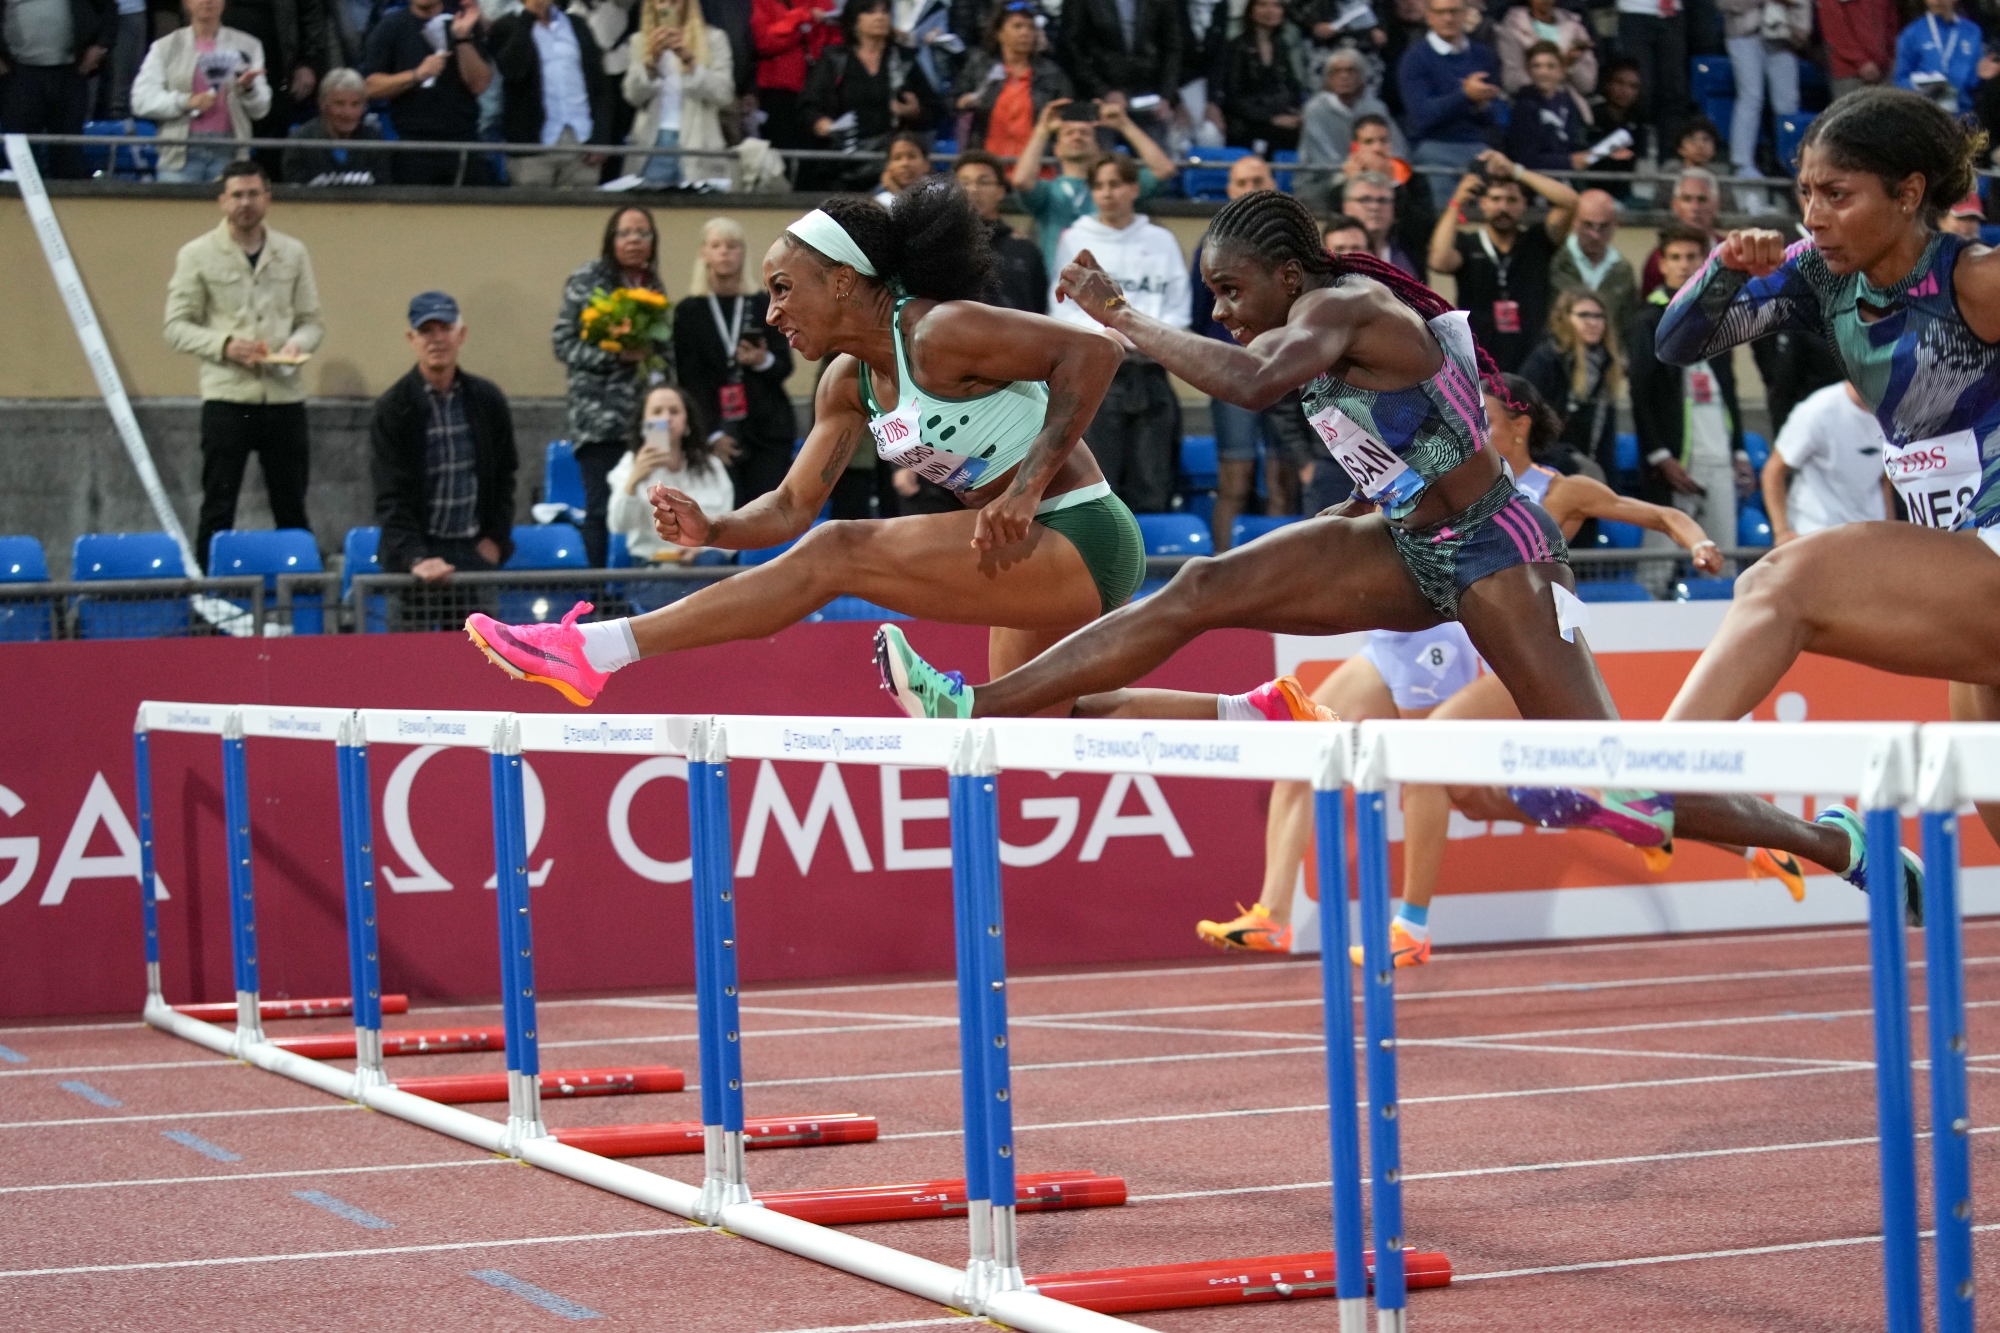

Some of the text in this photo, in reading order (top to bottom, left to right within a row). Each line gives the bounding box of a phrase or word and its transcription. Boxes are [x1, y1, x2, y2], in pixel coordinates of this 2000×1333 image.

[882, 418, 909, 443] UBS
[1430, 647, 1444, 666] 8
[844, 735, 874, 751] DIAMOND
[876, 735, 901, 751] LEAGUE
[1159, 742, 1200, 760] DIAMOND
[1203, 744, 1240, 763] LEAGUE
[1625, 748, 1685, 773] DIAMOND
[1692, 750, 1744, 774] LEAGUE
[607, 756, 1194, 884] OMEGA
